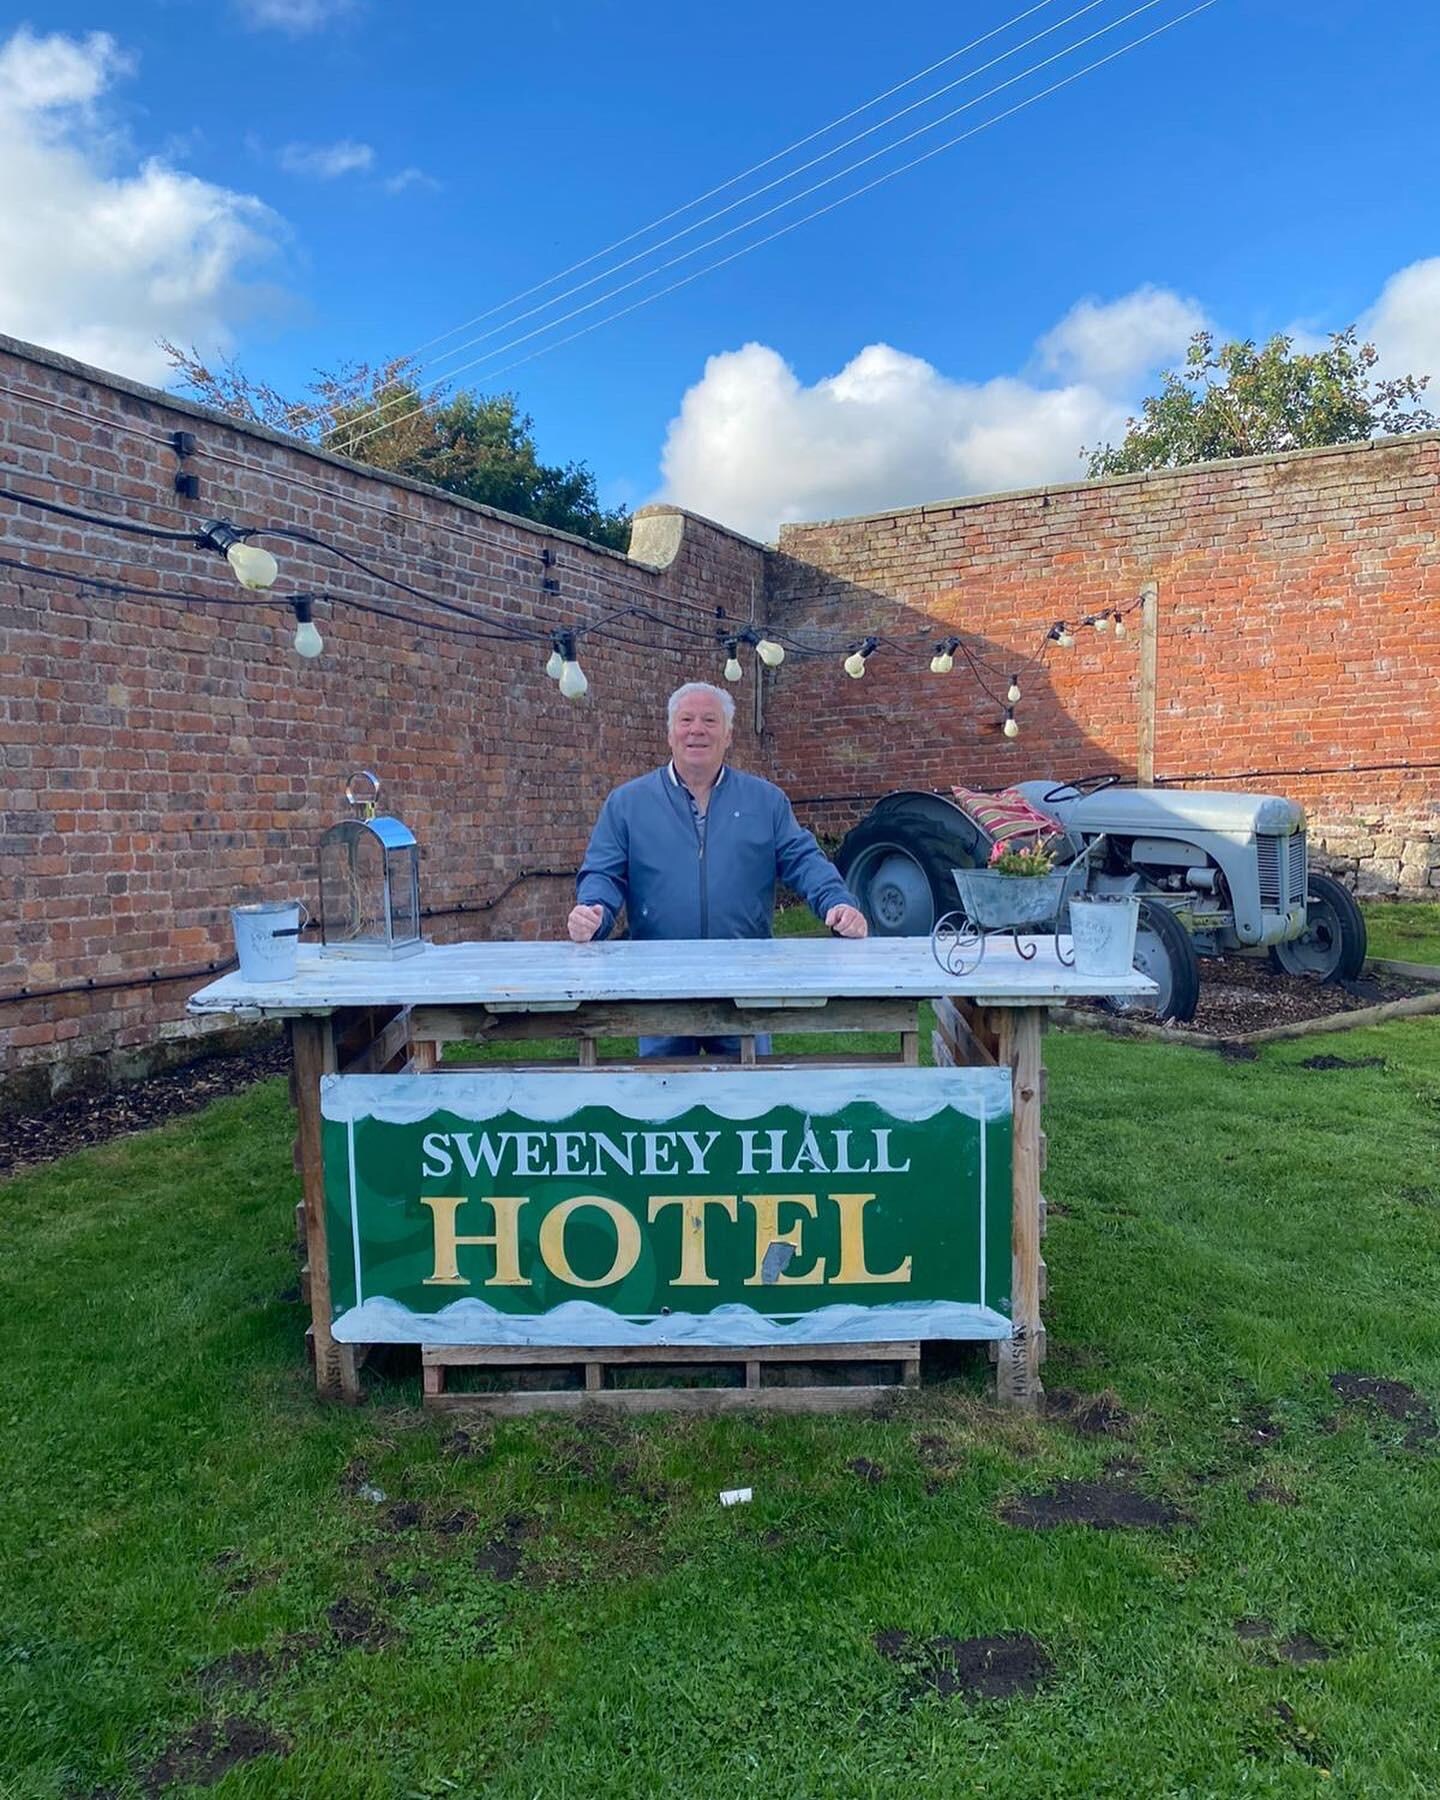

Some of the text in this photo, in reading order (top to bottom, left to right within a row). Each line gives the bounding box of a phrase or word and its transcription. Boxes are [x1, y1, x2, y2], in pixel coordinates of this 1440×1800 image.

[422, 1129, 911, 1177] SWEENEY HALL
[420, 1193, 912, 1288] HOTEL
